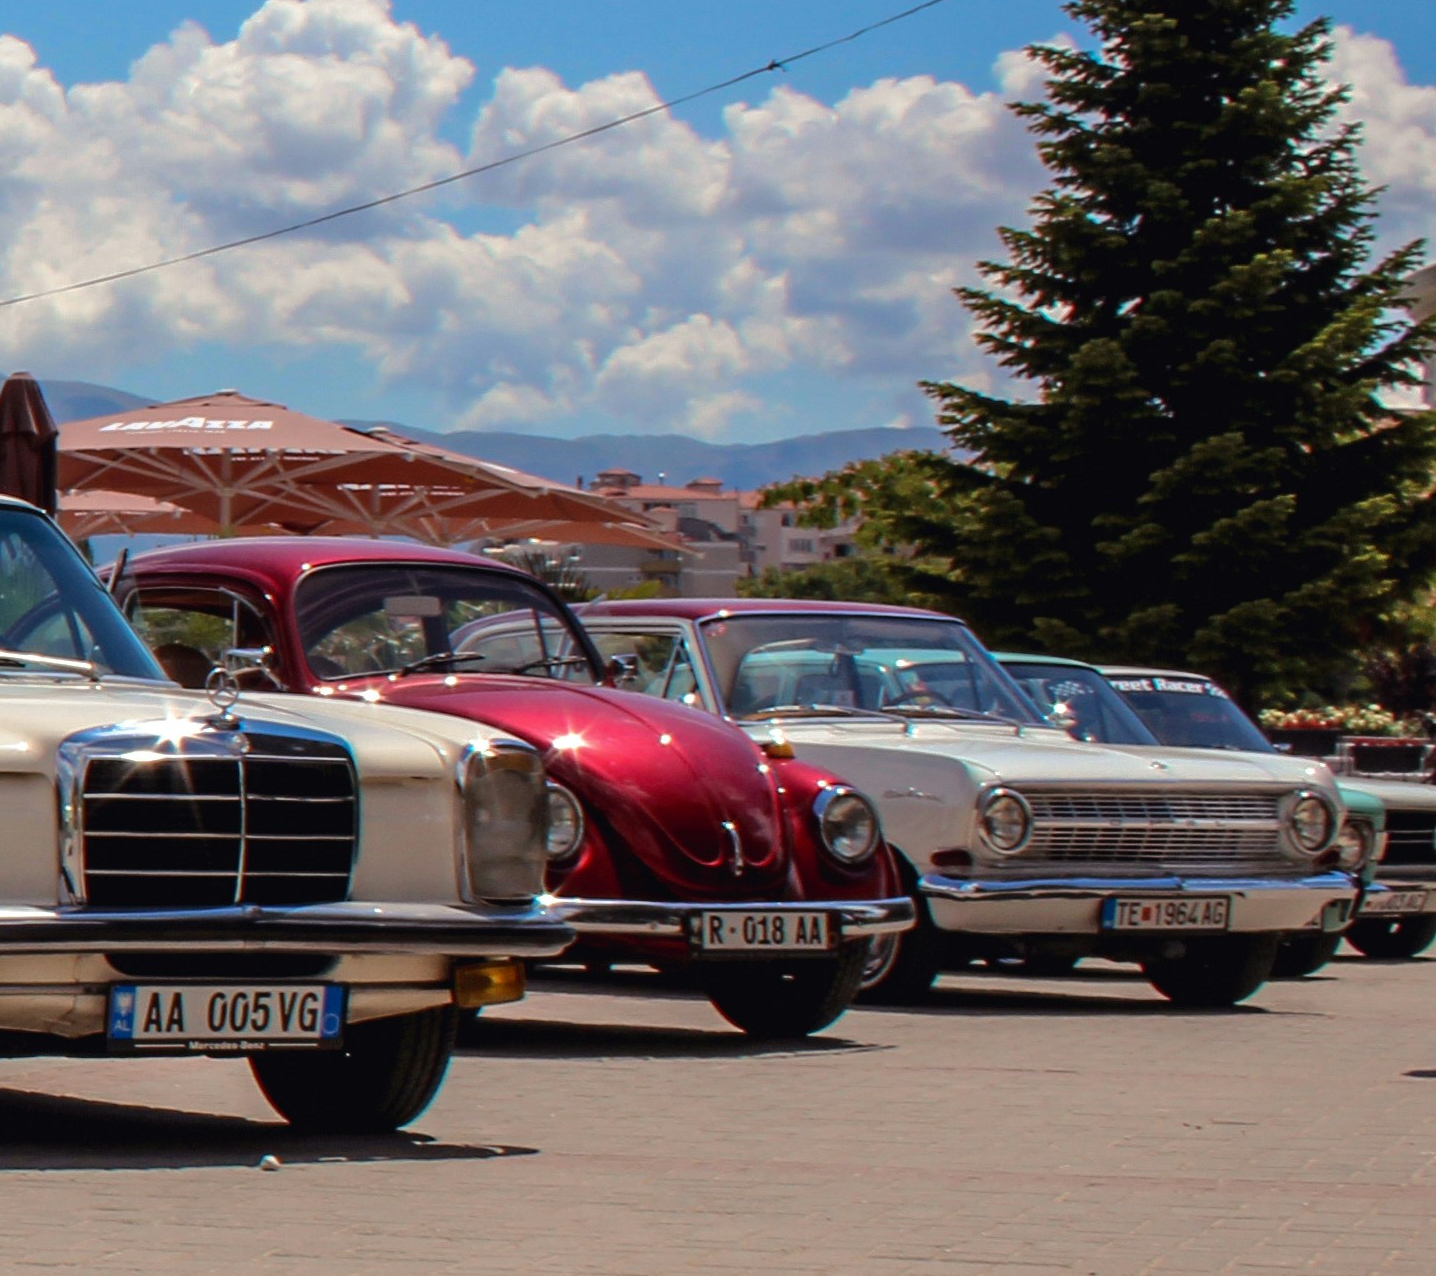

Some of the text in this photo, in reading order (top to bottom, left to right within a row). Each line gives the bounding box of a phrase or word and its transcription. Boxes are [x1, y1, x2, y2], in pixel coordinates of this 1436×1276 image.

[99, 416, 275, 432] LAVAZZA
[1153, 677, 1204, 693] Racer
[1118, 902, 1141, 926] TE
[795, 915, 822, 944] AA
[143, 992, 185, 1033] AA
